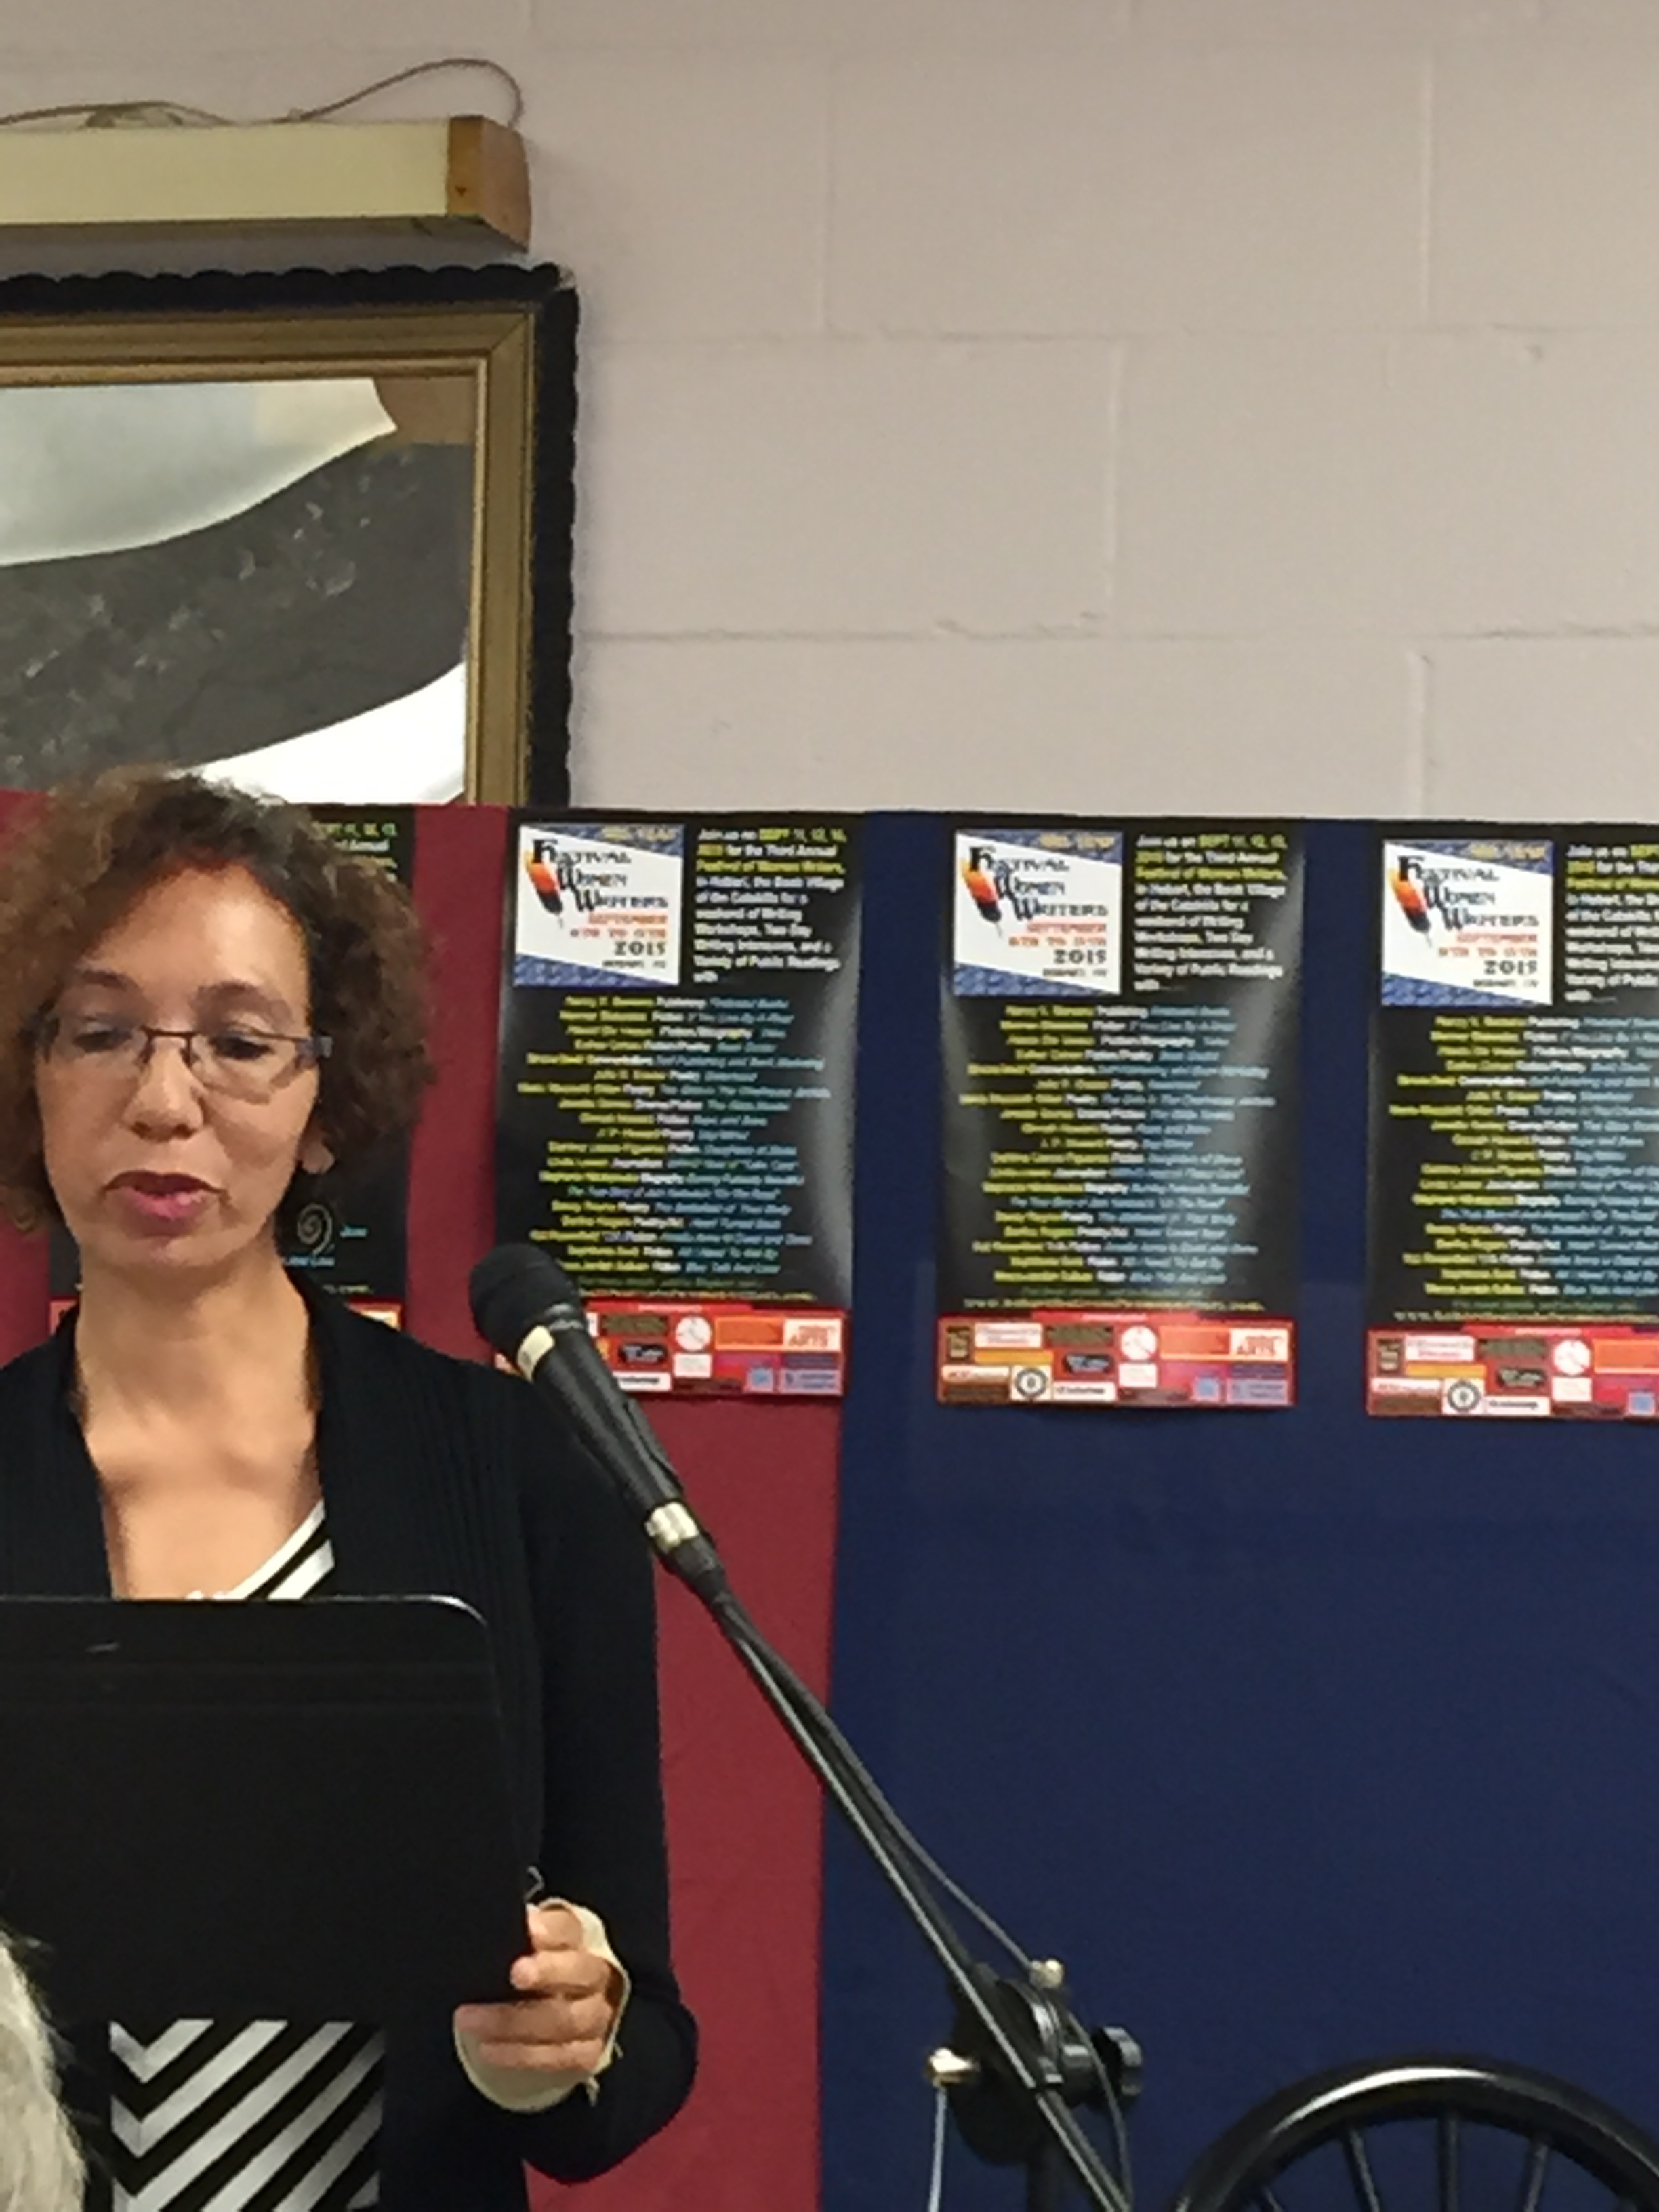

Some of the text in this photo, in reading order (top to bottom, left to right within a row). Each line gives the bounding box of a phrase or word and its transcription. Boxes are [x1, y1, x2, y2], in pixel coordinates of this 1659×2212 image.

[532, 839, 632, 864] FESTIVAL
[970, 846, 1070, 872] FESTIVAL
[558, 863, 627, 890] WOMEN
[1398, 855, 1500, 882] FESTIVAL
[995, 868, 1065, 899] WOMEN
[1424, 882, 1495, 909] WOMEN
[575, 888, 668, 912] WRITERS
[1016, 898, 1109, 921] WRITERS
[1443, 907, 1539, 931] WRITERS
[614, 941, 667, 956] 2015
[1054, 949, 1107, 964] 2015
[1484, 960, 1537, 975] 2015
